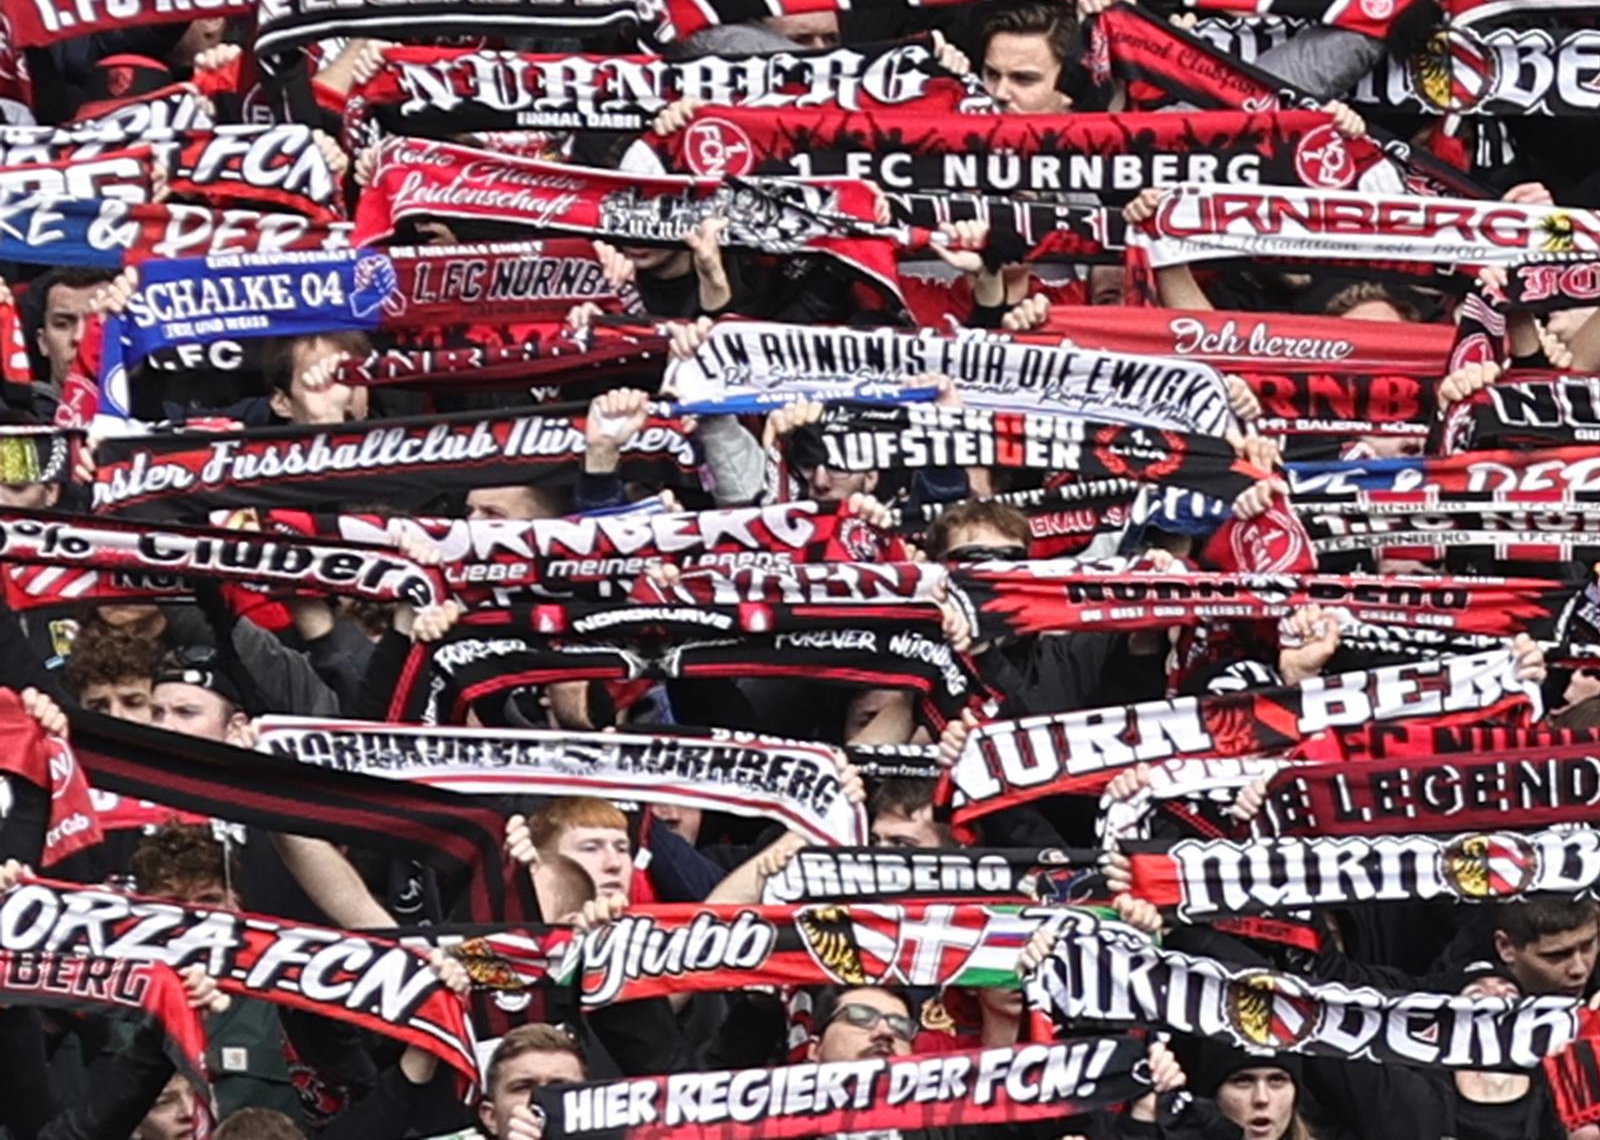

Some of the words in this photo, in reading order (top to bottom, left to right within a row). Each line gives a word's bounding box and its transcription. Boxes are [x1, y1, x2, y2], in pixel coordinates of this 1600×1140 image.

[845, 152, 916, 190] FC
[944, 147, 1262, 190] NÜRNBERG
[128, 274, 295, 327] SCHALKE
[301, 270, 345, 306] 04
[764, 327, 927, 377] BÜNDNIS
[1018, 350, 1082, 389] DIE
[203, 421, 497, 484] Fussballclub
[245, 929, 435, 1023] FCN
[562, 1080, 659, 1132] HIER
[665, 1059, 890, 1124] REGIERT
[889, 1062, 979, 1104] DER
[976, 1037, 1117, 1104] FCN!
